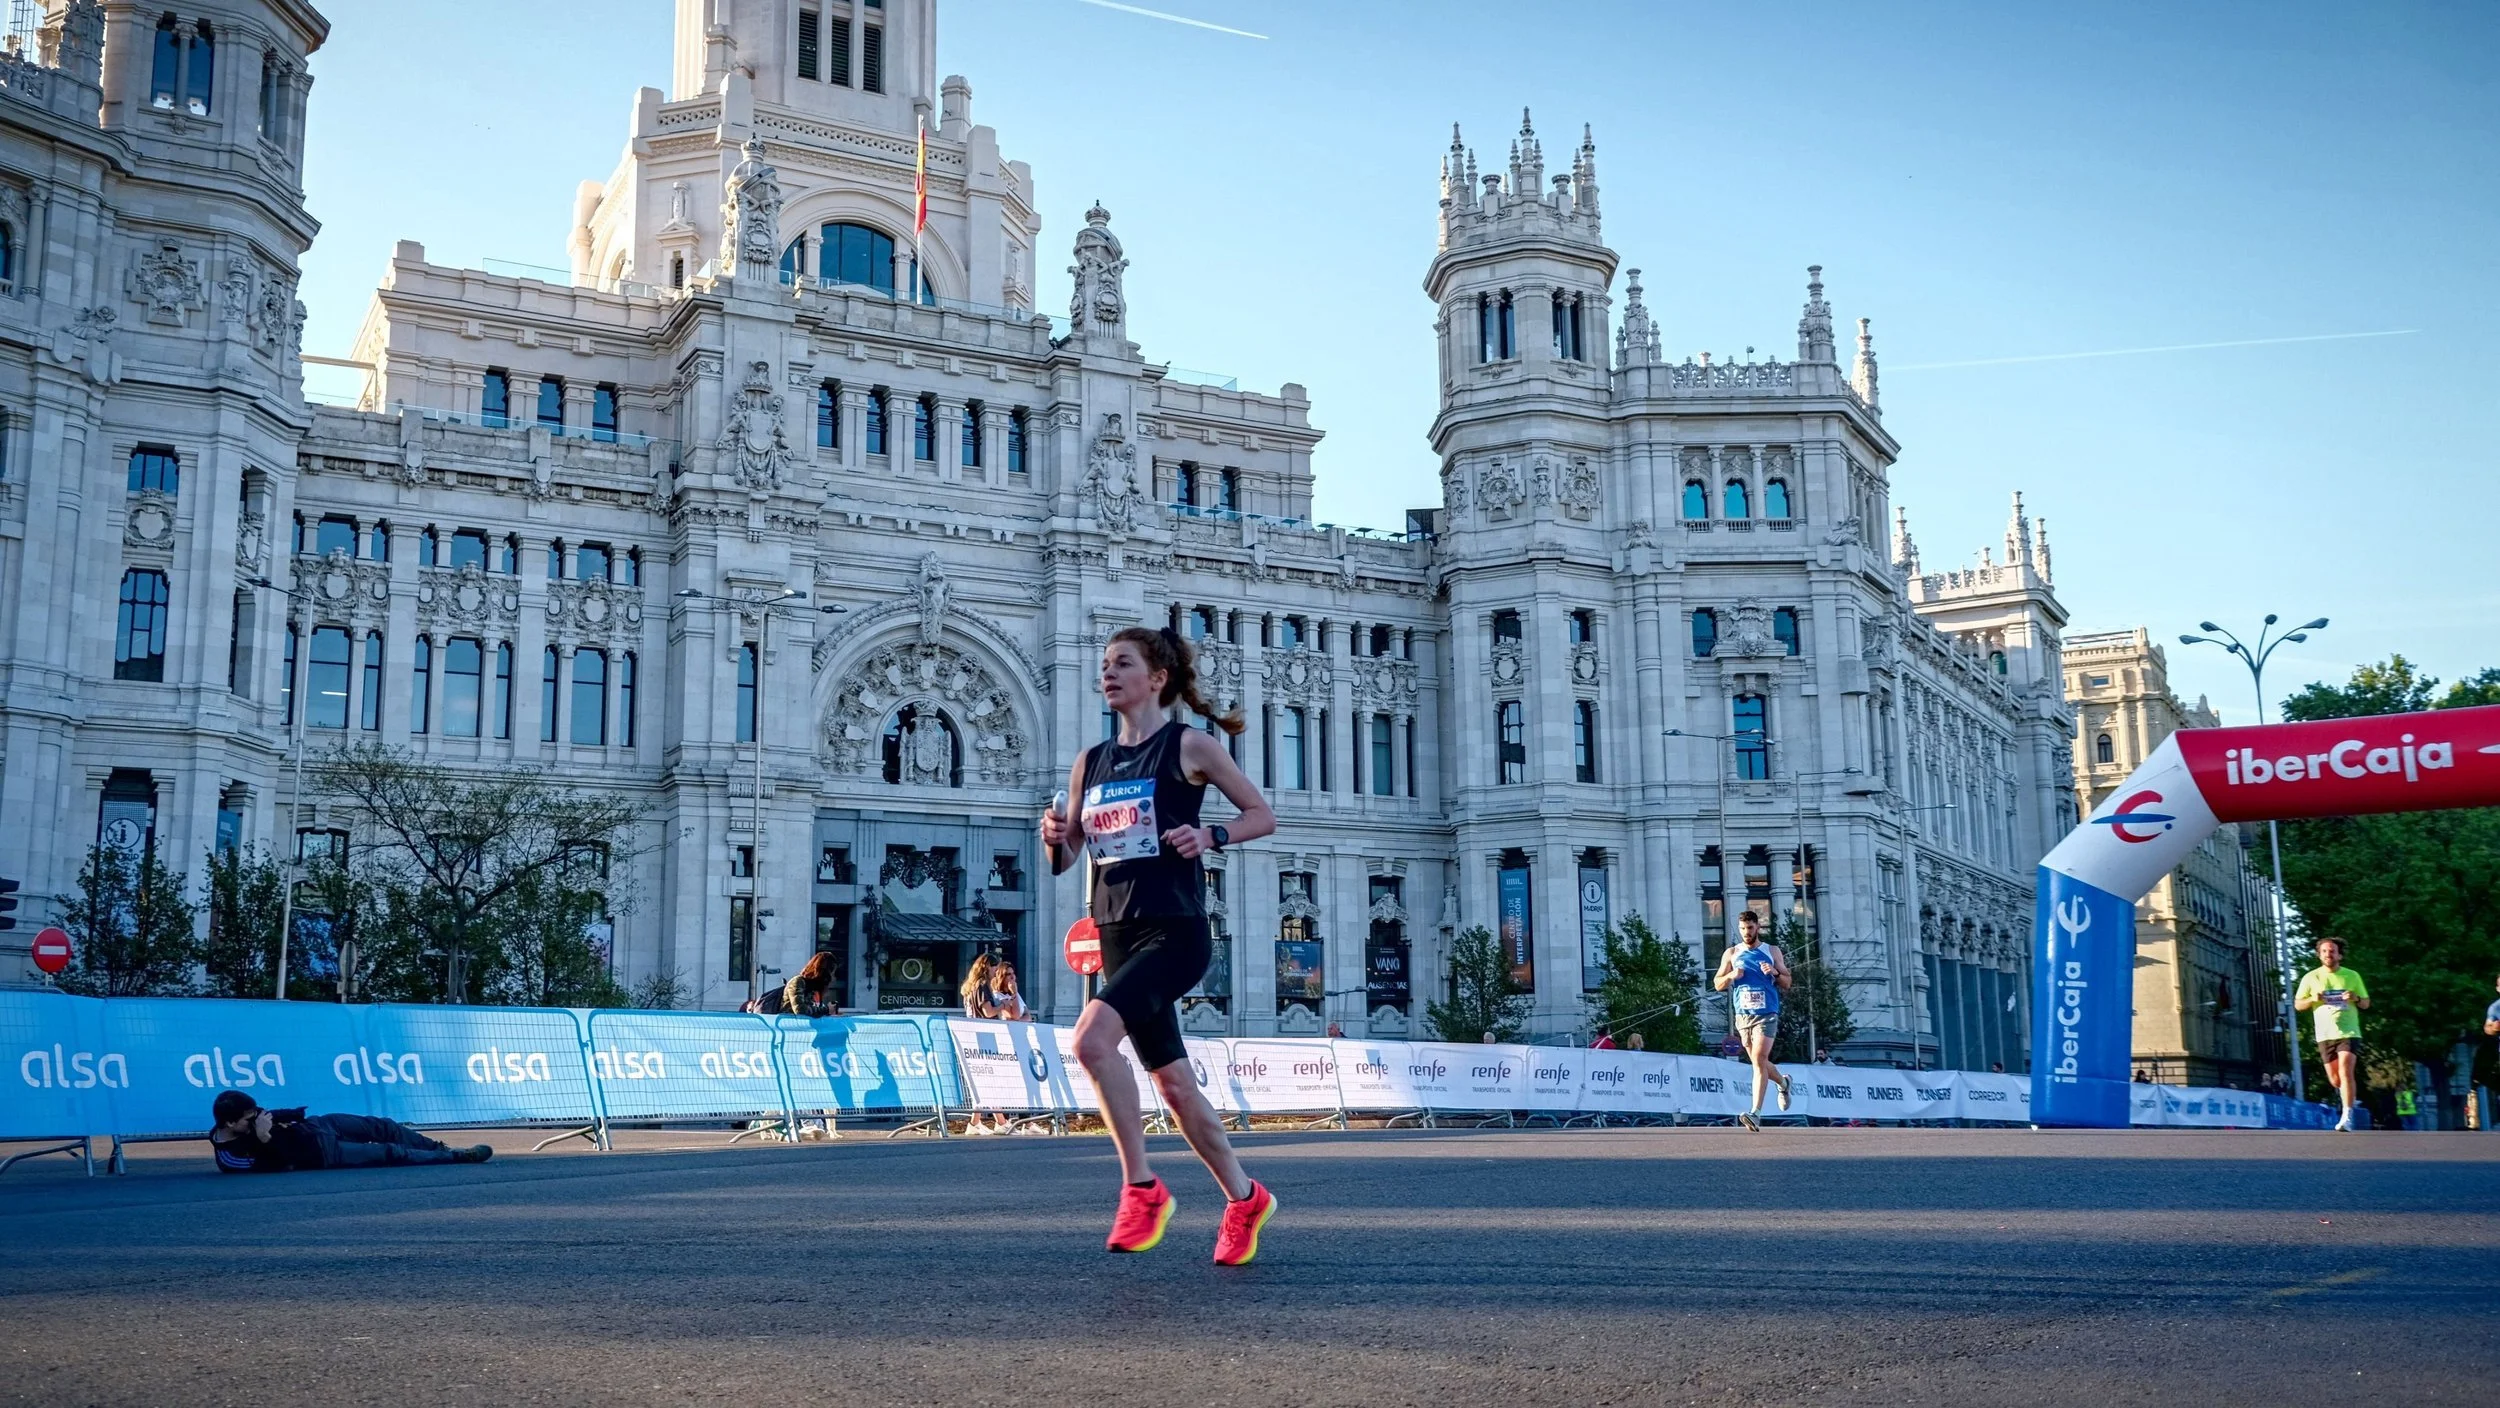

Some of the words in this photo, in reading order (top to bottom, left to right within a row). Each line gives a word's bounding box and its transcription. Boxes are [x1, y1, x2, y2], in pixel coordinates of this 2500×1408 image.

[2225, 733, 2454, 785] iberCaja
[1104, 785, 1141, 798] ZURICH
[1094, 806, 1137, 831] 40380
[1507, 898, 1515, 908] DE
[880, 995, 917, 1005] CENTRO
[2054, 961, 2088, 1083] iberCaja
[20, 1042, 129, 1089] alsa
[183, 1046, 286, 1088] alsa
[333, 1046, 424, 1085] alsa
[466, 1046, 551, 1083] alsa
[589, 1044, 666, 1079] alsa
[700, 1045, 772, 1078] alsa
[800, 1046, 860, 1078] alsa
[886, 1046, 941, 1077] alsa
[963, 1048, 984, 1060] BMW
[984, 1049, 1019, 1062] Motorrad
[1227, 1056, 1267, 1082] renfe
[1293, 1056, 1333, 1081] renfe
[1356, 1056, 1388, 1080] renfe
[1408, 1059, 1446, 1082] renfe
[1471, 1061, 1511, 1084] renfe
[1534, 1063, 1570, 1085] renfe
[1591, 1065, 1625, 1087] renfe
[1643, 1068, 1670, 1089] renfe
